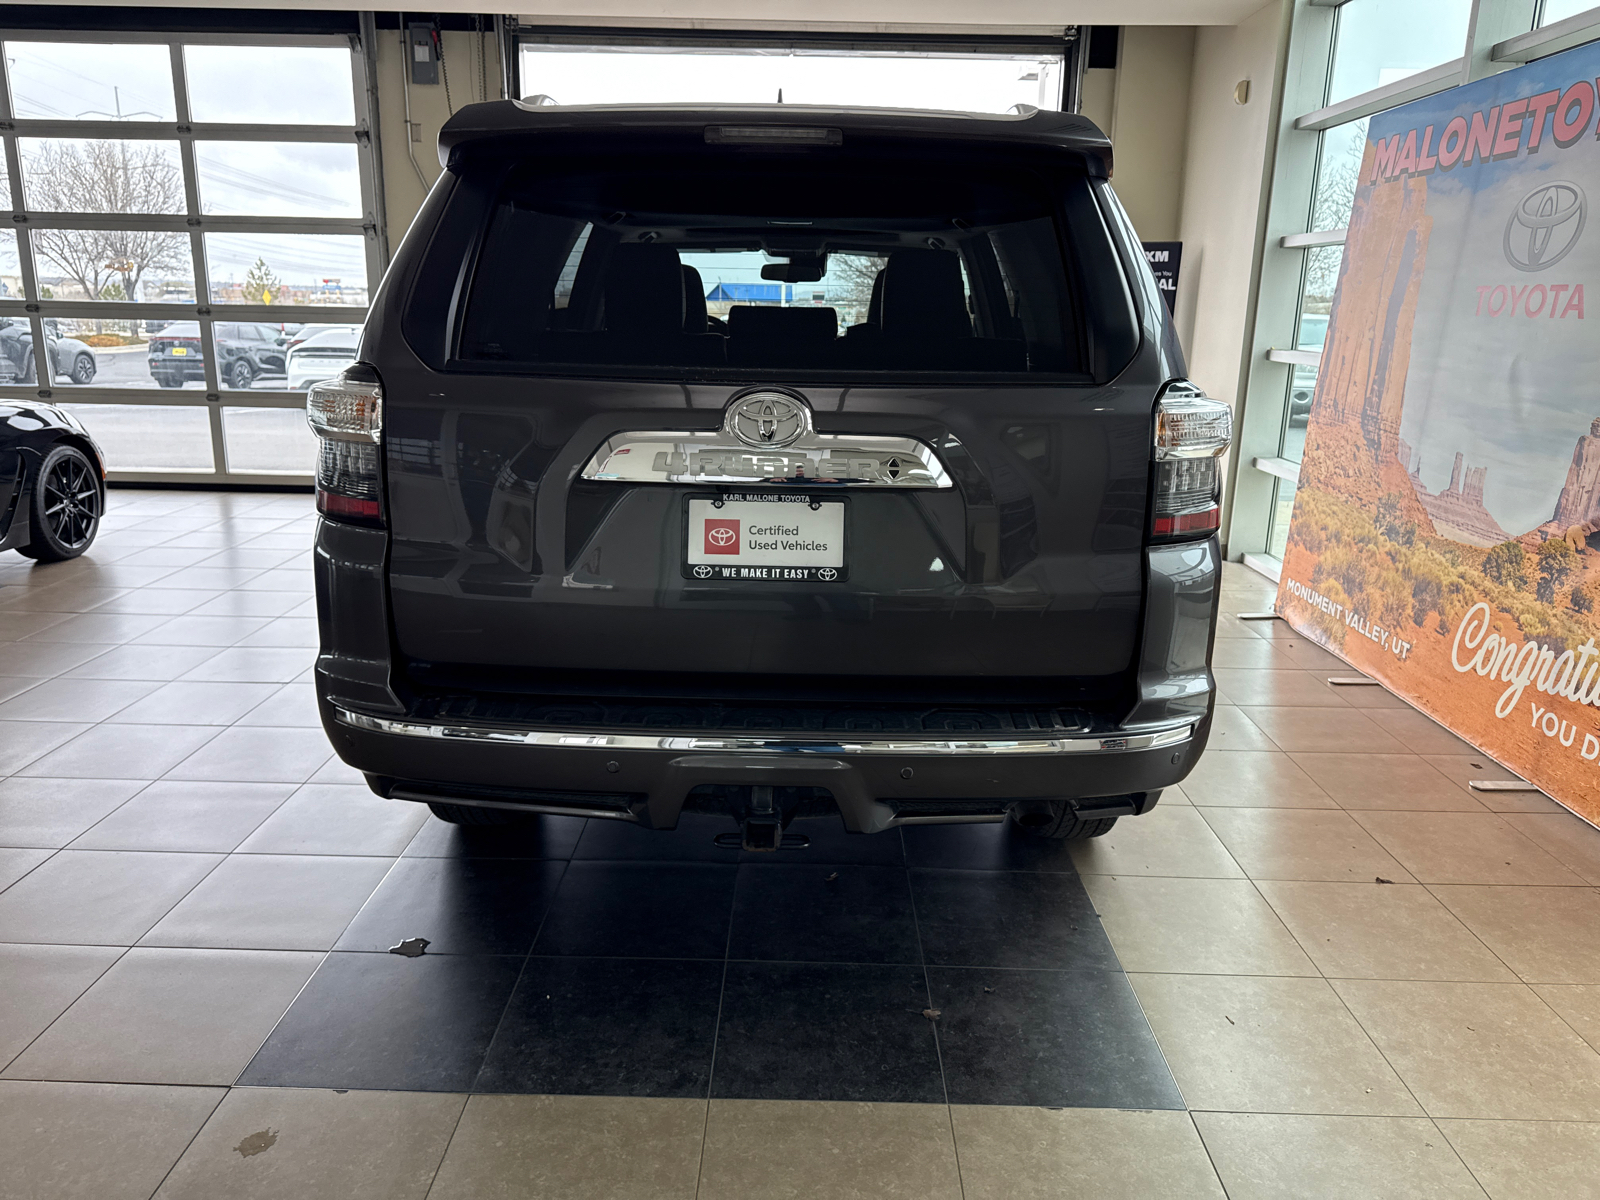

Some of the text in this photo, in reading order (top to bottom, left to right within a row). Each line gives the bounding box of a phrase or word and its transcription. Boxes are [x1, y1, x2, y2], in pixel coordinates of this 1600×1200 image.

[1370, 77, 1600, 186] MALONETO
[1158, 278, 1176, 290] AL
[1475, 284, 1585, 319] TOYOTA
[723, 493, 811, 503] KARL MALONE TOYOTA
[748, 525, 799, 536] Certified
[748, 540, 828, 551] Used Vehicles
[721, 567, 809, 579] WE MAKE IT EASY
[1286, 577, 1411, 659] MONUMENT VALLEY, UT
[1531, 702, 1600, 767] YOU D
